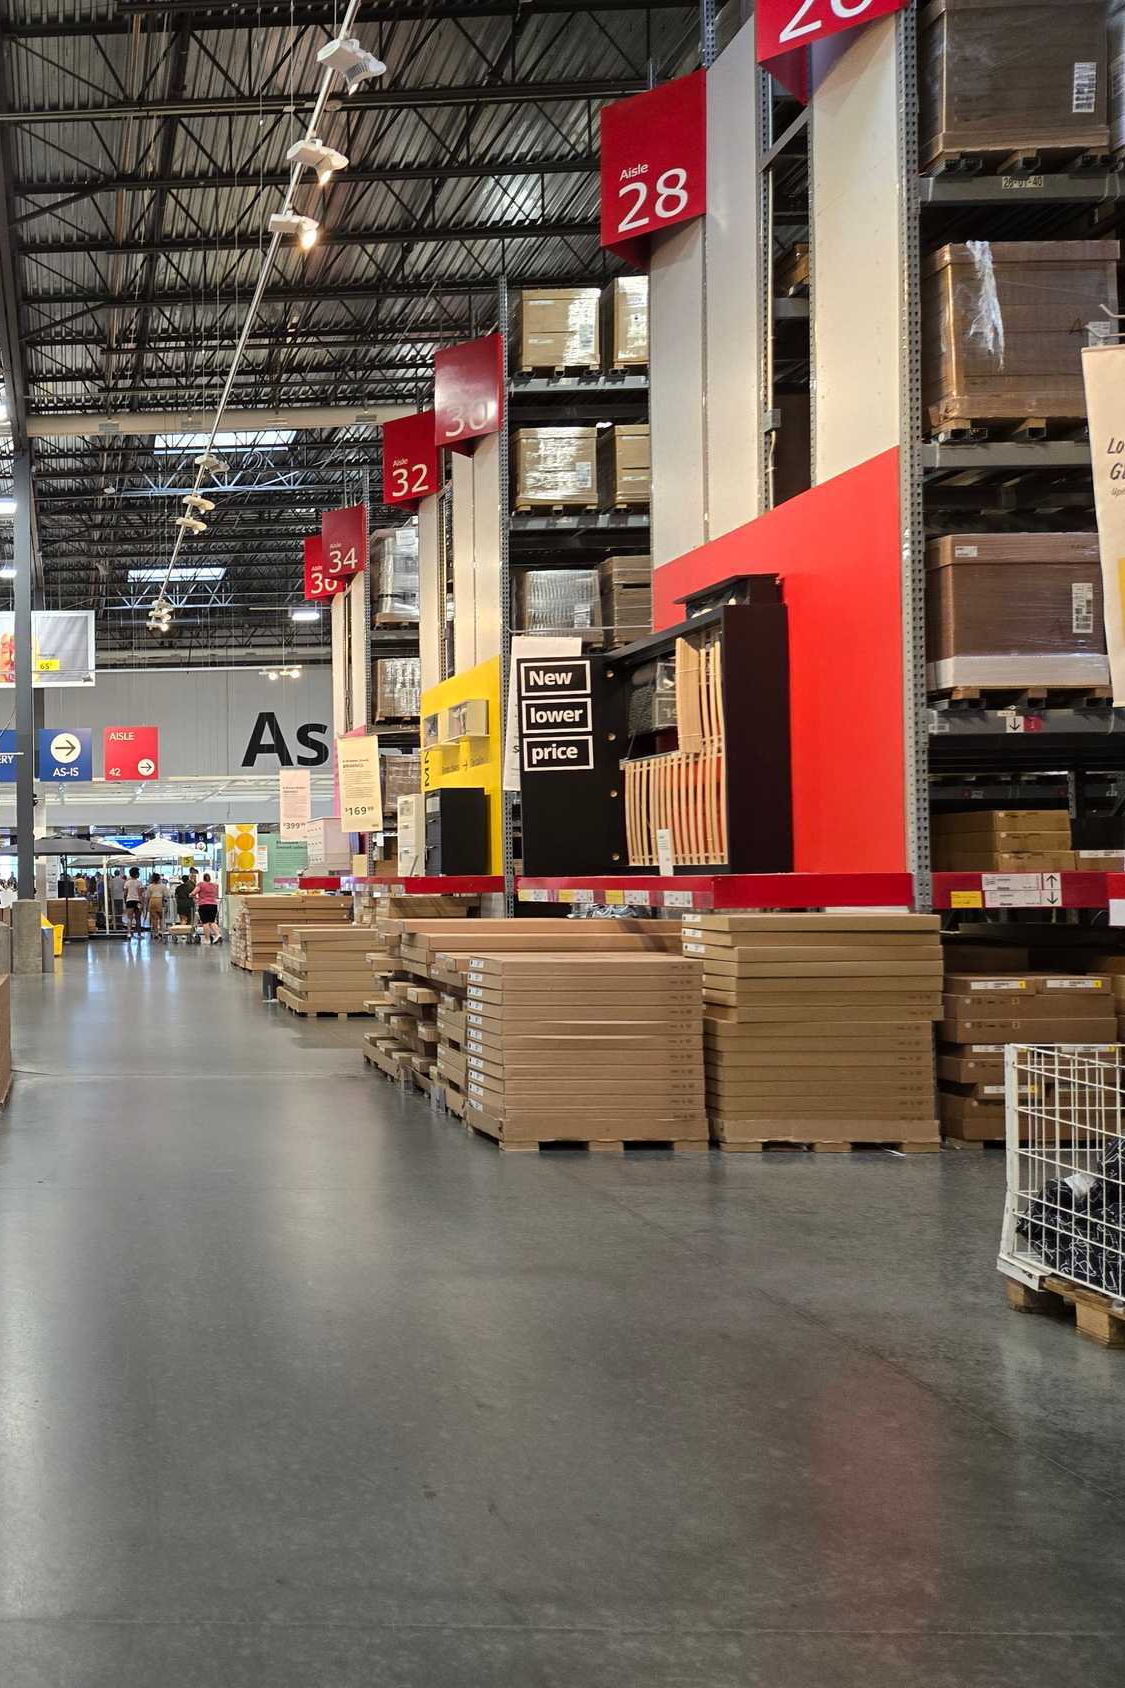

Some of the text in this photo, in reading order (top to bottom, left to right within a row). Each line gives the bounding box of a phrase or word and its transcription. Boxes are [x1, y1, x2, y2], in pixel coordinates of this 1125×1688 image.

[779, 0, 873, 43] 2
[620, 164, 649, 181] Aisle
[618, 168, 688, 233] 28
[393, 458, 409, 467] Aisle
[392, 464, 429, 497] 32
[329, 547, 358, 573] 34
[529, 670, 572, 686] New
[530, 708, 583, 723] lower
[109, 732, 134, 741] AISLE
[242, 712, 329, 767] As
[532, 744, 578, 765] price
[53, 767, 79, 777] AS-IS
[109, 768, 121, 777] 42
